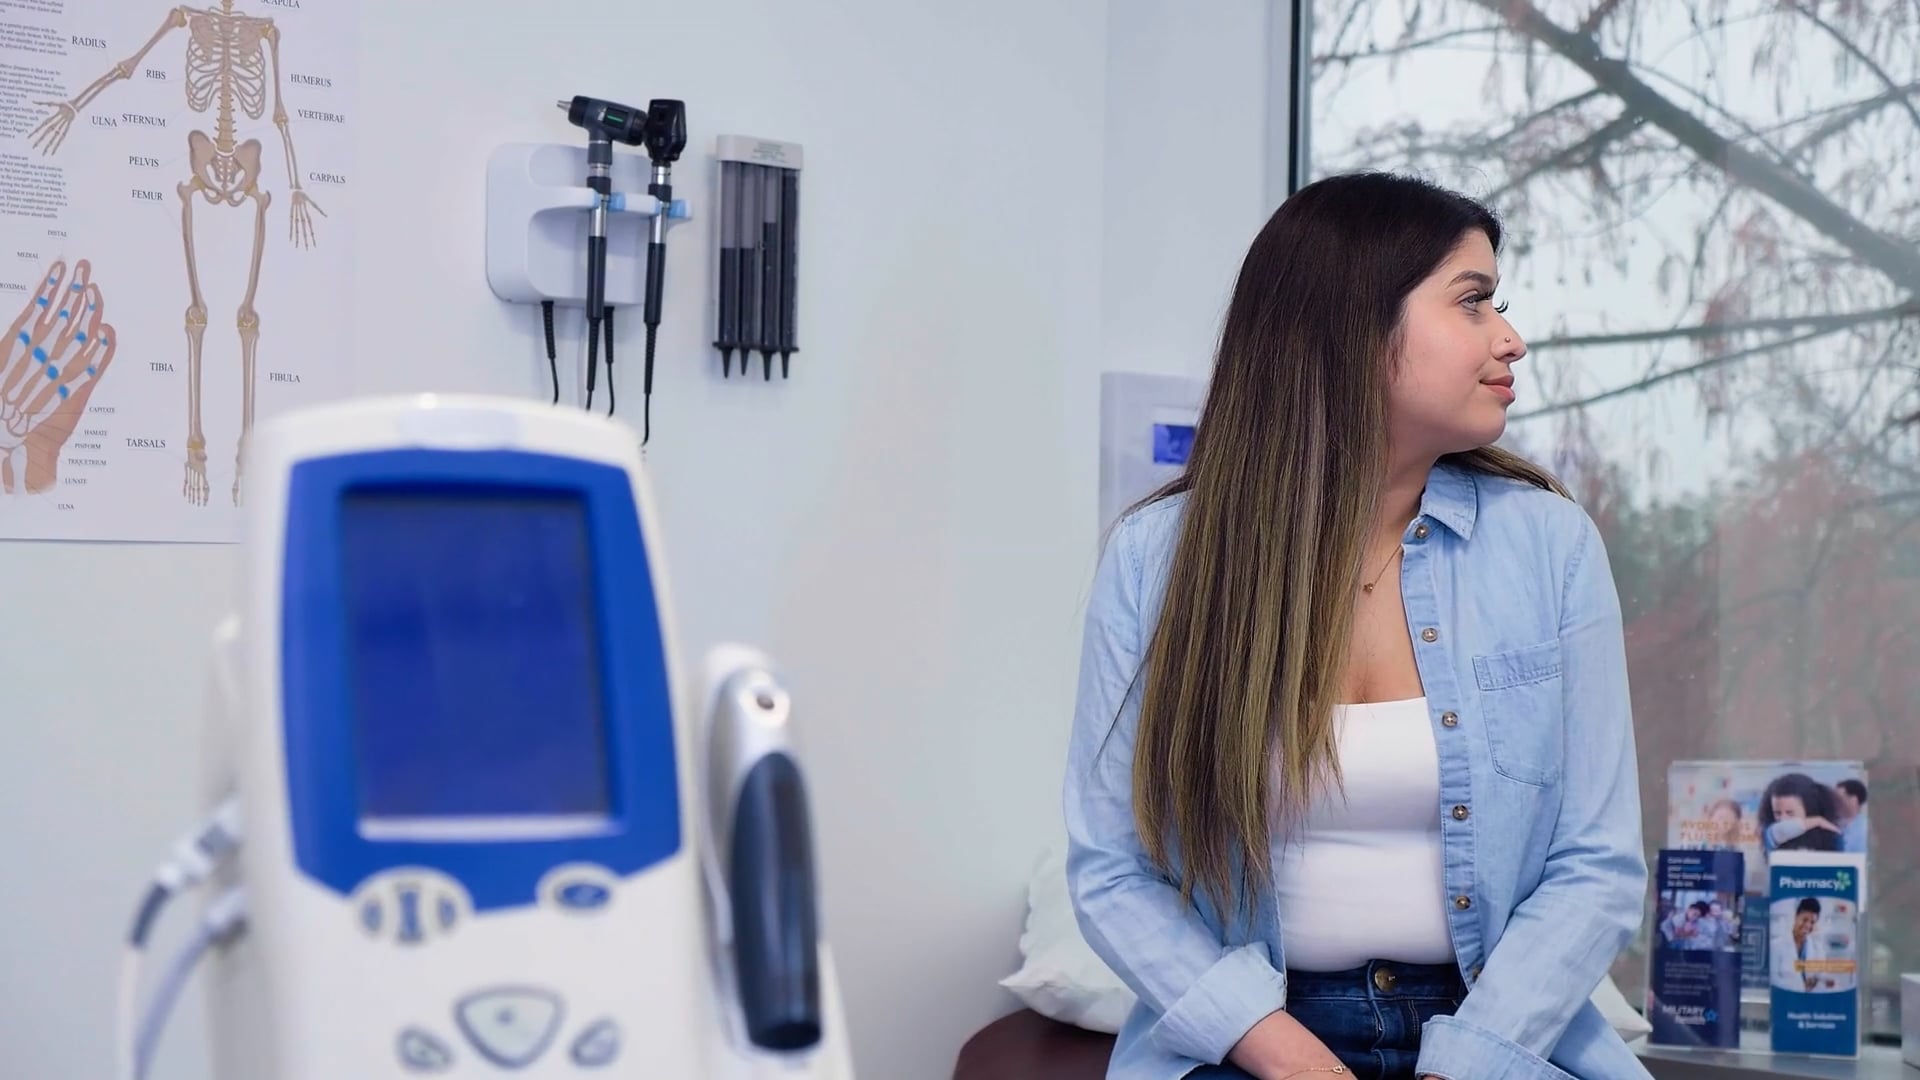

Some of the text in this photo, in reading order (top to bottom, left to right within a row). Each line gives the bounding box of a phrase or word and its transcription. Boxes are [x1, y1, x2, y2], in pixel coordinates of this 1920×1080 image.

[72, 35, 107, 49] RADIUS
[146, 68, 167, 81] RIBS
[290, 73, 332, 88] HUMERUS
[91, 115, 118, 128] ULNA
[122, 113, 166, 127] STERNUM
[297, 108, 345, 123] VERTEBRAE
[128, 156, 160, 168] PELVIS
[309, 172, 346, 184] CARPALS
[131, 189, 163, 201] FEMUR
[47, 229, 67, 238] DISTAL
[17, 251, 39, 260] MEDIAL
[150, 361, 174, 373] TIBIA
[269, 371, 301, 384] FIBULA
[89, 406, 116, 414] CAPITATE
[84, 429, 108, 437] HAMATE
[126, 437, 166, 450] TARSALS
[65, 477, 88, 485] LUNATE
[1779, 876, 1841, 892] Pharmacy
[1662, 1005, 1706, 1018] MILITARY
[1786, 1011, 1812, 1021] Health
[1805, 1021, 1836, 1030] Services
